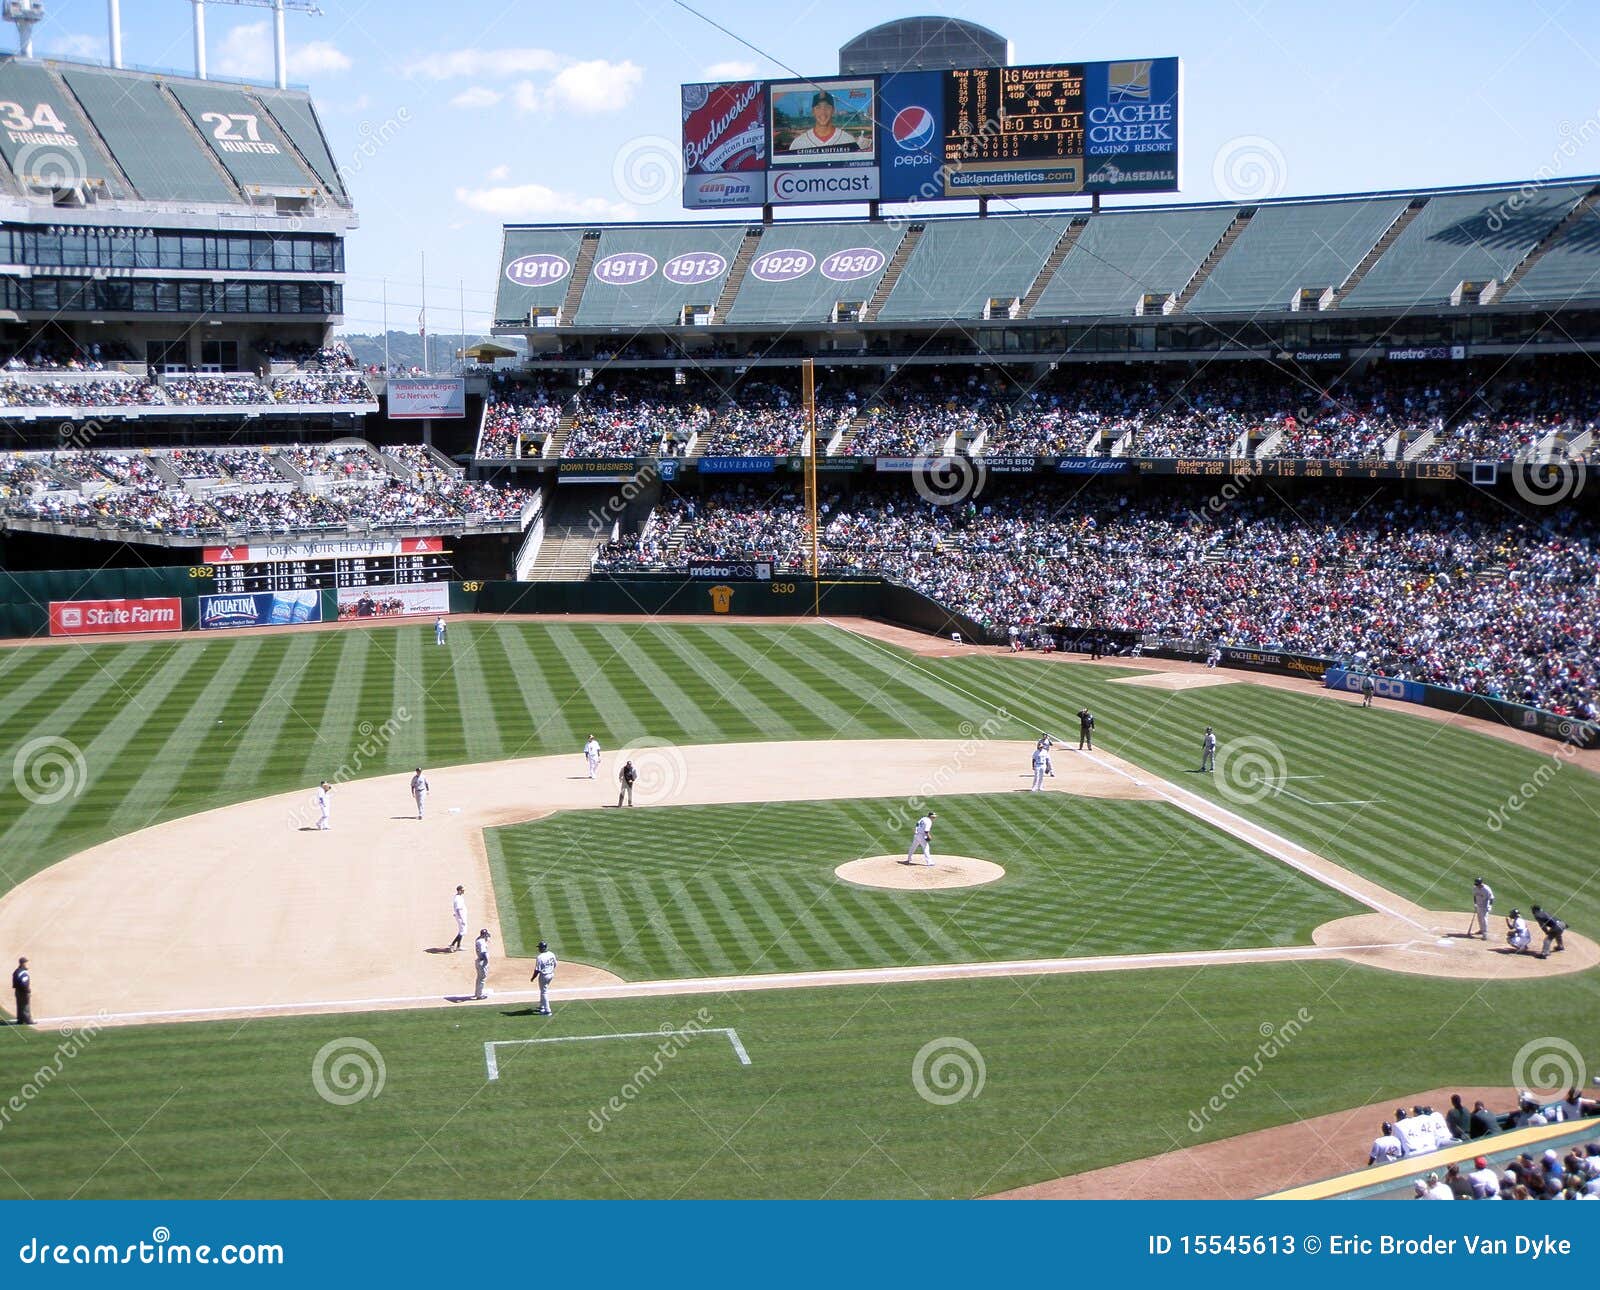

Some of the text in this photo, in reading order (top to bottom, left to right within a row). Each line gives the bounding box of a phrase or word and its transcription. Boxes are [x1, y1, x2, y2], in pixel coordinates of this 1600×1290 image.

[1004, 70, 1070, 83] 16 Kottaras
[0, 101, 67, 134] 34
[1089, 104, 1172, 124] CACHE
[201, 112, 262, 142] 27
[683, 80, 764, 173] Budweiser
[1090, 123, 1173, 143] CREEK
[8, 131, 79, 148] FINGERS
[219, 140, 281, 155] HUNTER
[1090, 143, 1172, 155] CASINO RESORT
[894, 153, 932, 168] pepsi
[953, 171, 1073, 184] oaklandathletics.com
[1118, 170, 1174, 182] BASEBALL
[782, 174, 870, 193] comcast
[514, 260, 564, 279] 1910
[602, 260, 648, 277] 1911
[670, 259, 721, 277] 1913
[758, 256, 809, 275] 1929
[830, 254, 878, 273] 1930
[1297, 352, 1341, 361] Chevy.com
[561, 463, 633, 472] DOWN TO BUSINESS
[713, 460, 770, 469] SILVERADO
[1015, 458, 1035, 466] BBQ
[1060, 461, 1087, 469] BUD
[1178, 460, 1224, 468] Anderson
[1358, 461, 1389, 469] STRIKE
[664, 466, 673, 475] 42
[1176, 467, 1200, 475] TOTAL
[1205, 467, 1222, 475] 105
[1284, 469, 1296, 477] 16
[1370, 470, 1377, 478] 0
[1425, 465, 1452, 477] 1:52
[266, 542, 385, 557] JOHN MUIR HEALTH
[189, 568, 214, 578] 362
[690, 565, 753, 577] metroPCS
[463, 582, 484, 592] 367
[772, 584, 796, 593] 330
[205, 595, 259, 620] AQUAFINA
[1346, 673, 1405, 698] GCO
